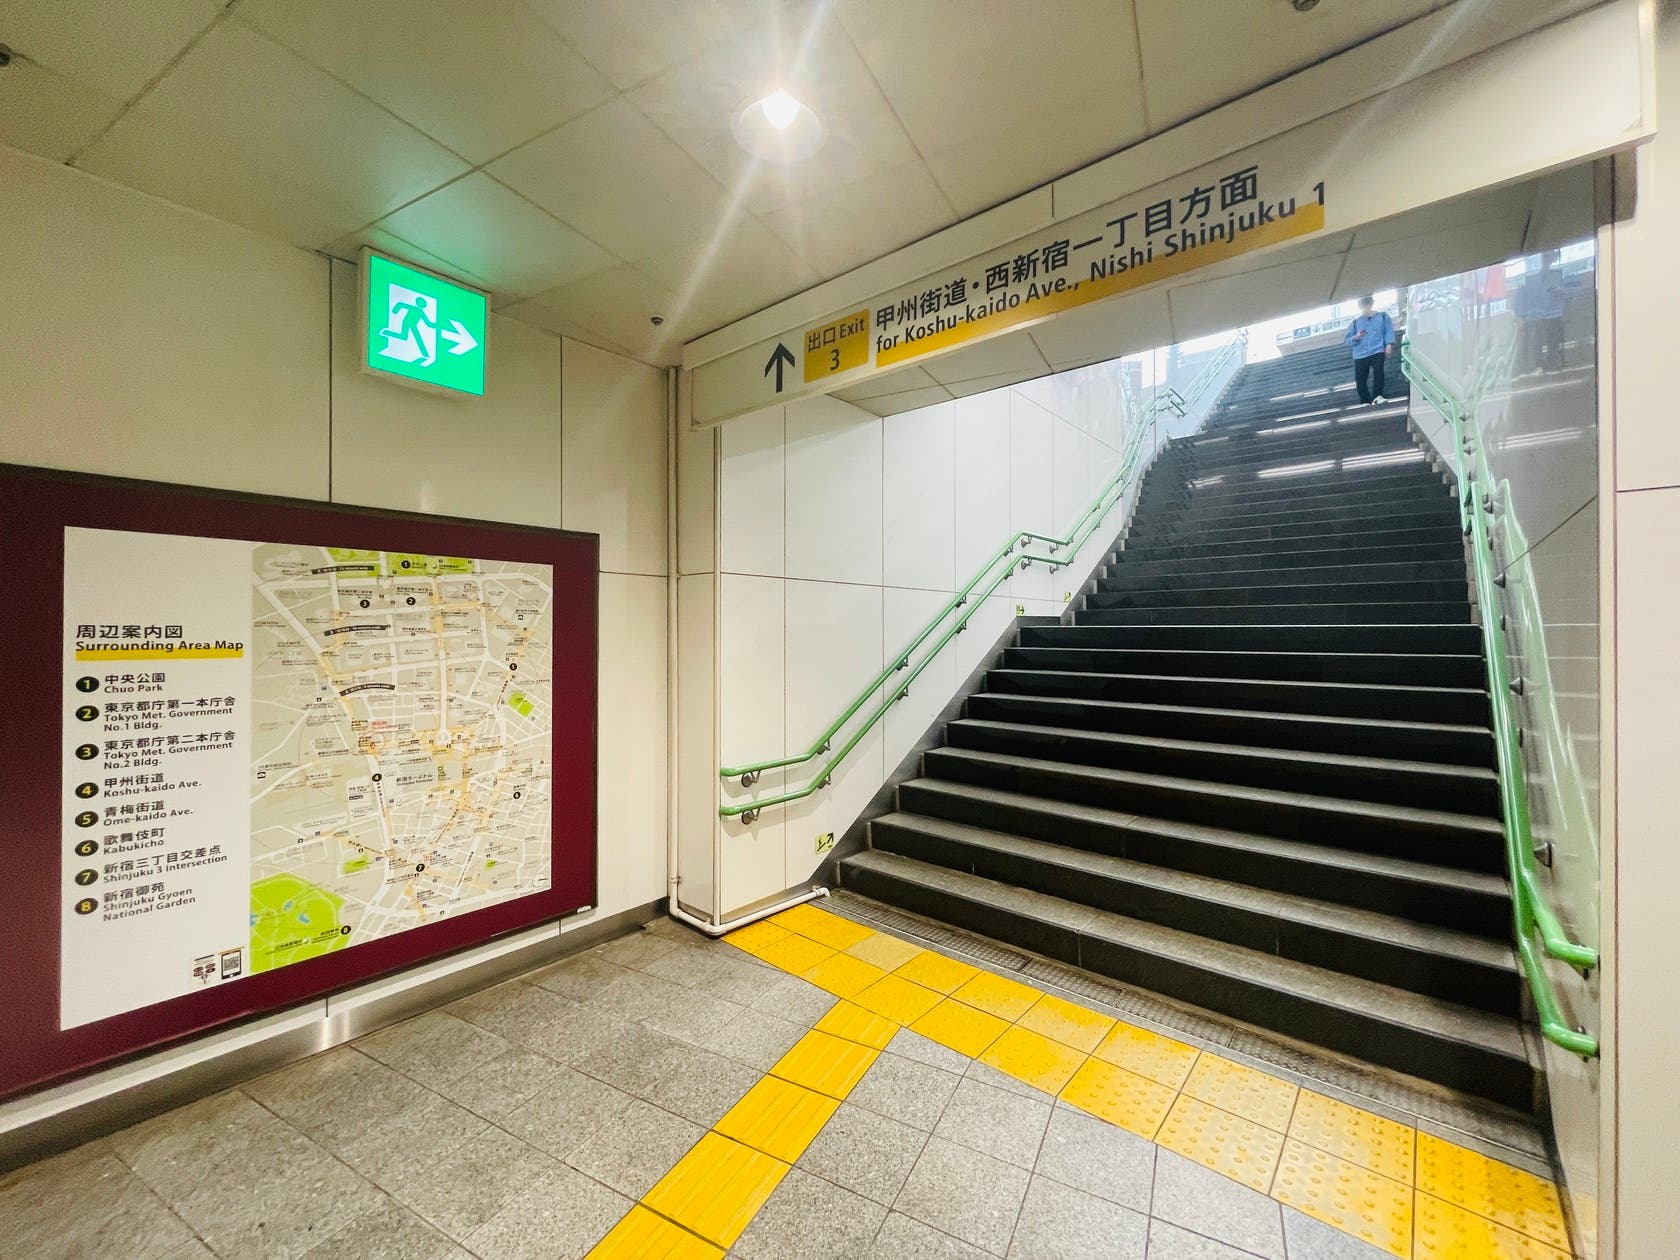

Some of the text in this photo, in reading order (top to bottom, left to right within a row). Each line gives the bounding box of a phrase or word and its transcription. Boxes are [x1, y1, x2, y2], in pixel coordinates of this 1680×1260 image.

[876, 165, 1258, 332] 甲州街道・西新宿一丁目方面
[876, 181, 1325, 353] for Koshu-kaido Ave., Nishi Shinjuku 1
[808, 318, 864, 353] 出口 Exit
[830, 348, 840, 371] 3
[76, 624, 182, 638] 周辺案内図
[76, 640, 244, 652] Surrounding Area Map
[105, 672, 165, 685] 中央公園
[104, 696, 235, 712] 東京都庁第一本庁舎
[104, 714, 138, 722] Tokyo
[169, 708, 232, 718] Government
[134, 721, 162, 730] Bldg.
[104, 730, 235, 751] 東京都庁第二本庁舎
[104, 752, 138, 760] Tokyo
[169, 742, 232, 754] Government
[104, 758, 162, 769] No.2 Bldg.
[104, 773, 164, 788] 甲州街道
[104, 783, 175, 797] Koshu-kaido
[104, 800, 165, 817] 青梅街道
[104, 812, 166, 826] Ome-kaido
[104, 828, 165, 845] 歌舞伎町
[104, 840, 164, 855] Kabukicho
[104, 845, 221, 874] 新宿三丁目交差点
[104, 869, 153, 883] Shinjuku
[104, 882, 164, 902] 新宿御苑
[104, 888, 192, 912] Shinjuku Gyoen
[104, 897, 196, 921] National Garden
